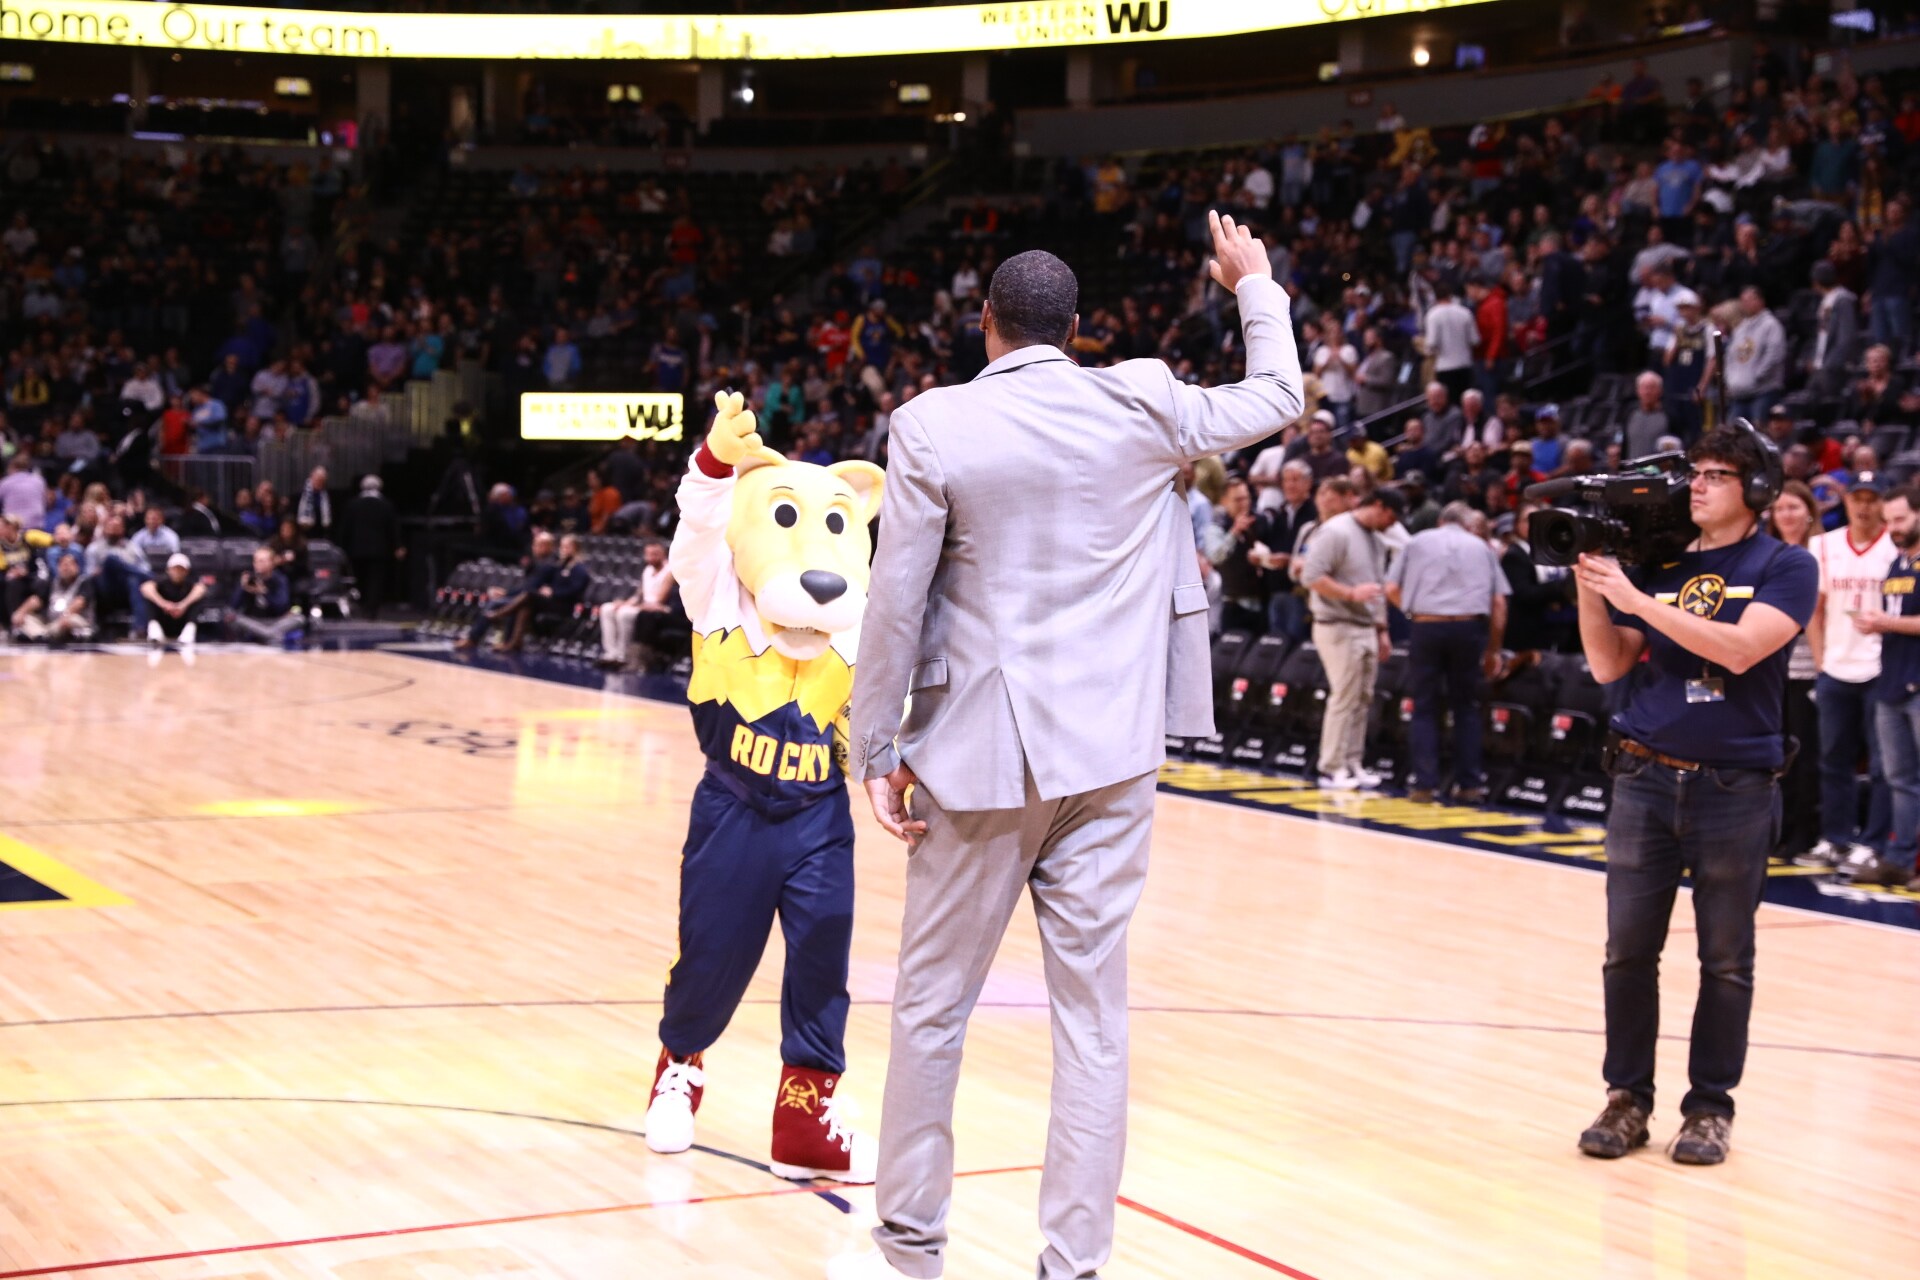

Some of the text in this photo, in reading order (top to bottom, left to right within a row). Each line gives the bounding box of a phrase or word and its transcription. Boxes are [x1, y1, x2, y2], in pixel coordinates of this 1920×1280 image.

[0, 0, 390, 51] home. Our team.
[1106, 1, 1168, 34] WU
[730, 723, 831, 782] ROCKY
